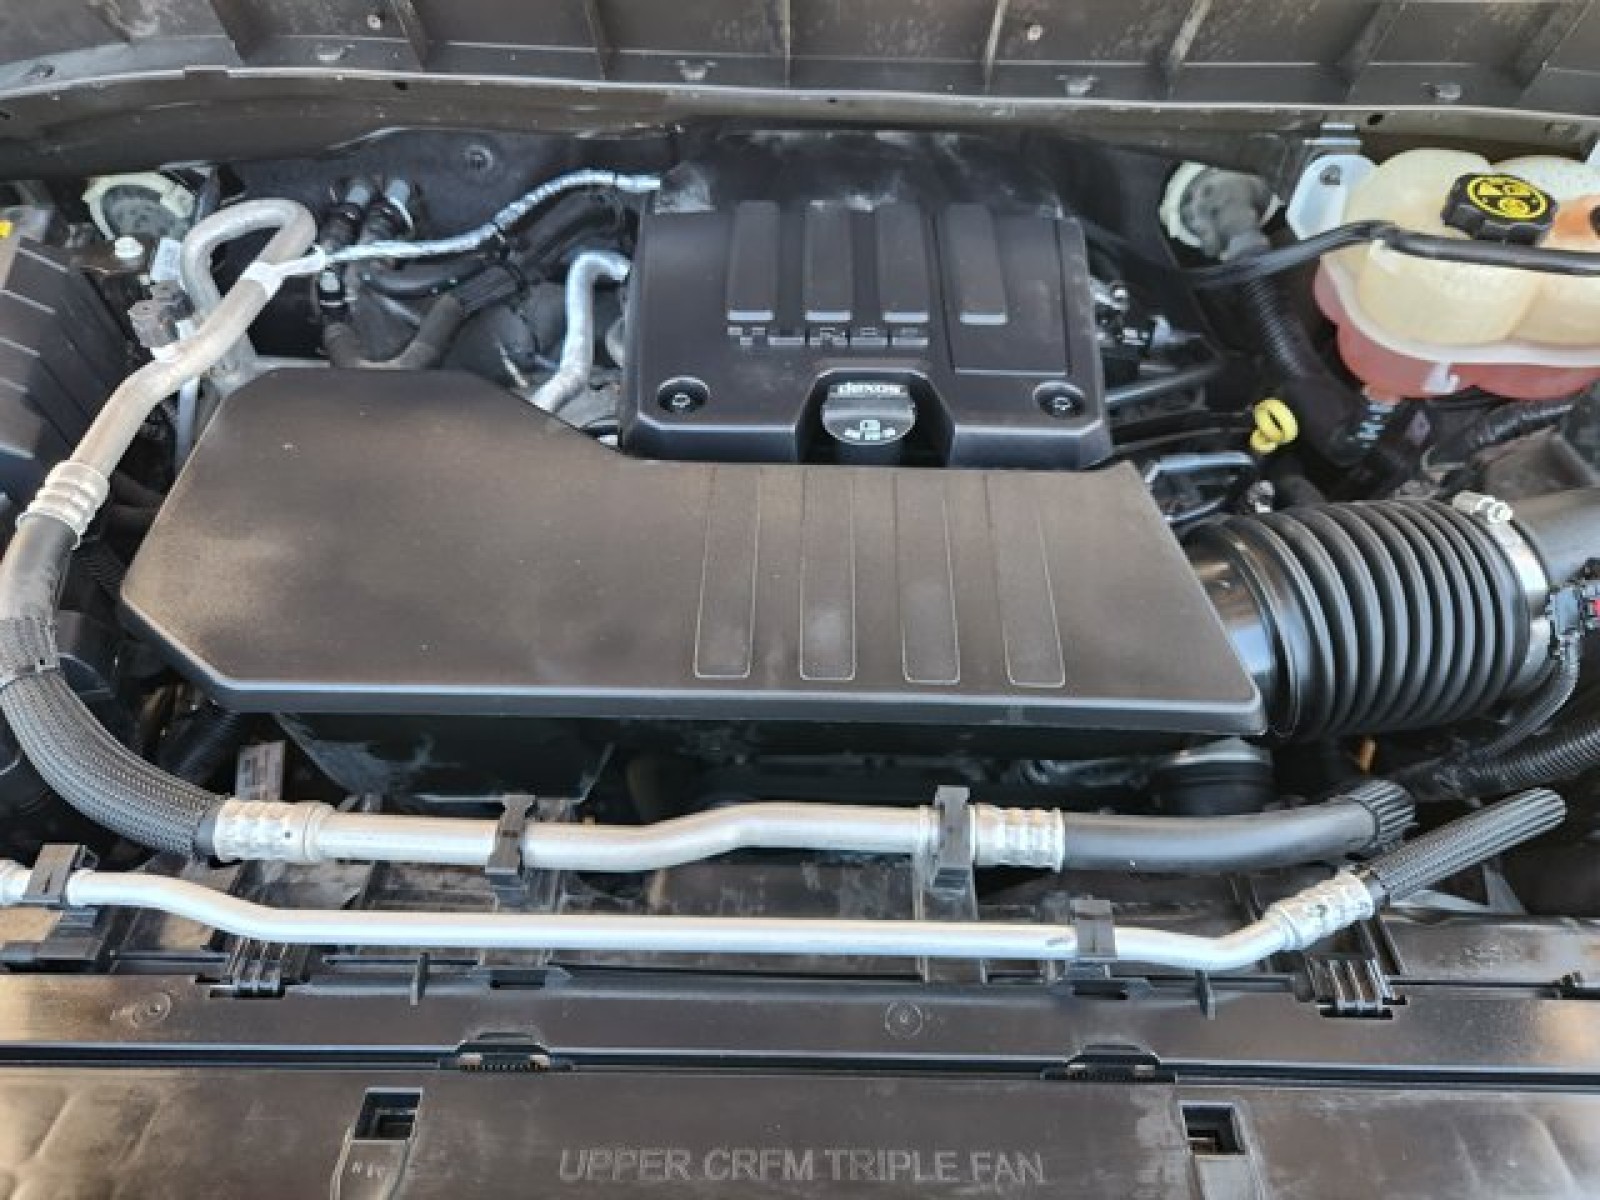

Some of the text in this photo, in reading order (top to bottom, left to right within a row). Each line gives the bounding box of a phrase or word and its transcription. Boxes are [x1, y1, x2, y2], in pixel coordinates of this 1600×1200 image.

[559, 1148, 1046, 1186] UPPER CRFM TRIPLE FAN
